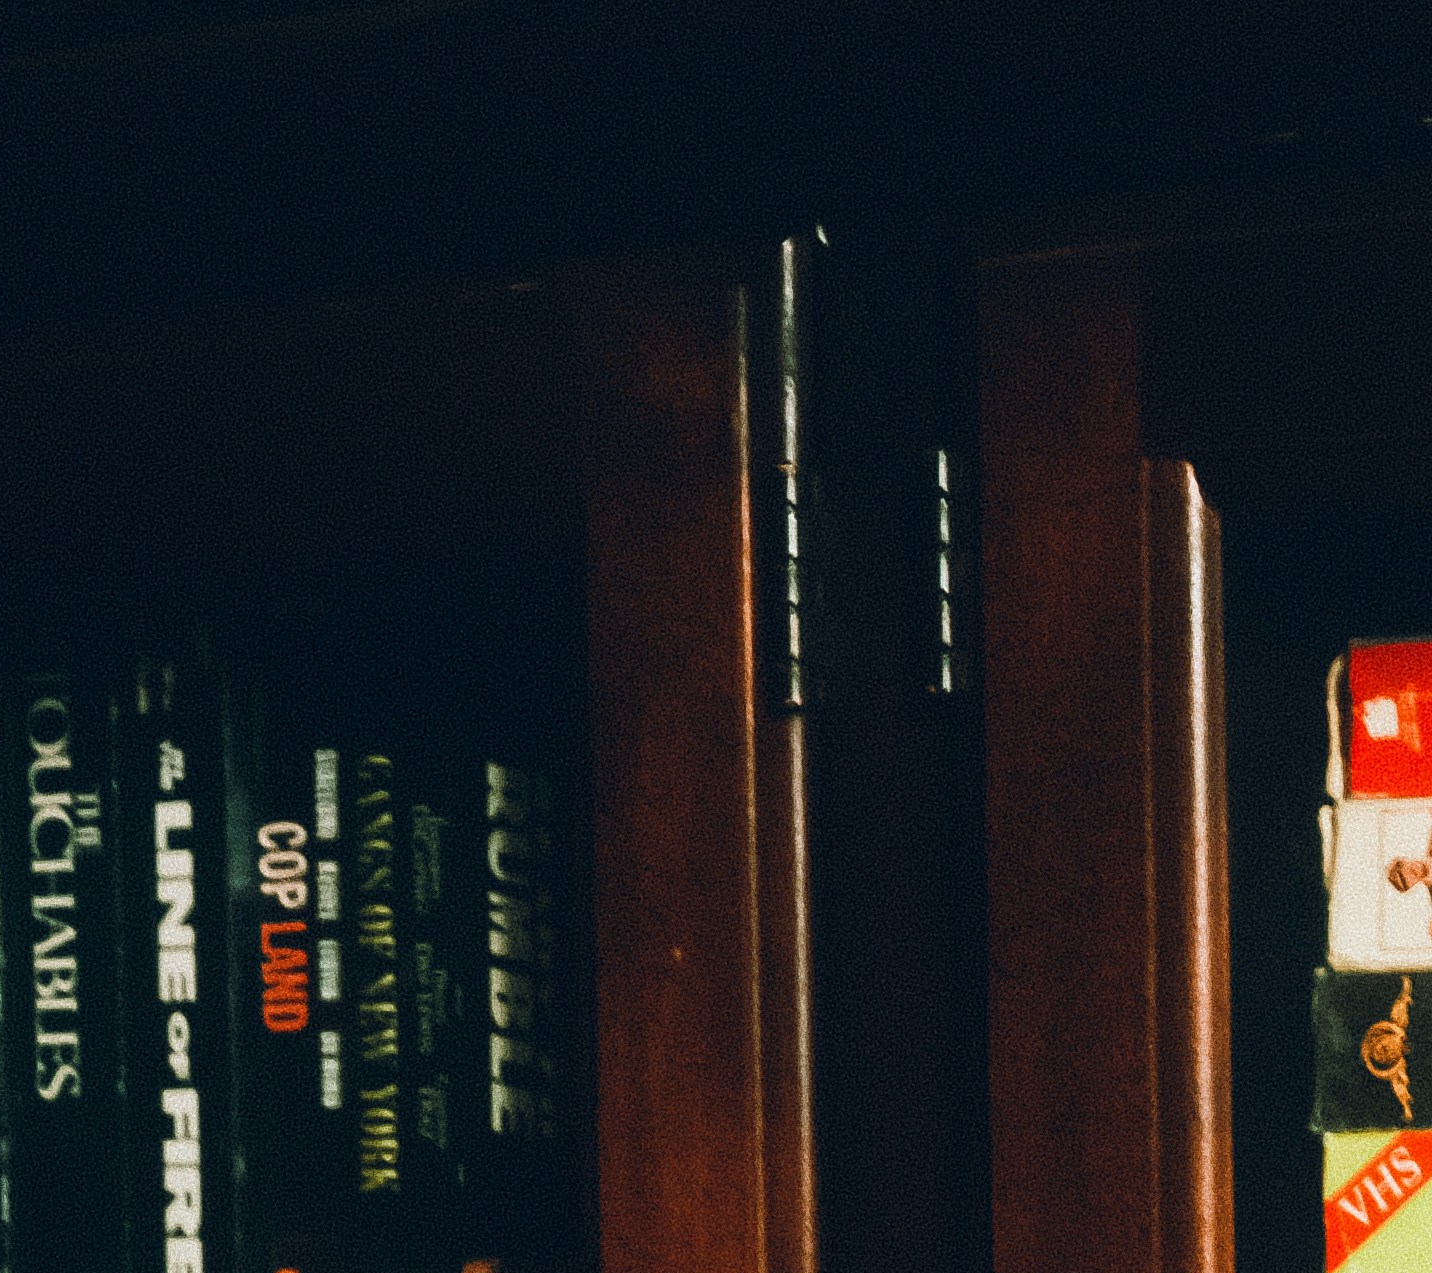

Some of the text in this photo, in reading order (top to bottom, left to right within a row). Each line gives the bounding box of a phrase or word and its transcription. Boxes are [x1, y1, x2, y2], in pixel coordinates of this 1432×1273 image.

[154, 799, 199, 1003] LINE
[257, 820, 311, 1033] COP LAND
[355, 752, 401, 1194] GANGS OF NEW YORK
[484, 757, 556, 1142] RUMBLE
[166, 1011, 190, 1082] OF
[1339, 1145, 1423, 1227] VHS
